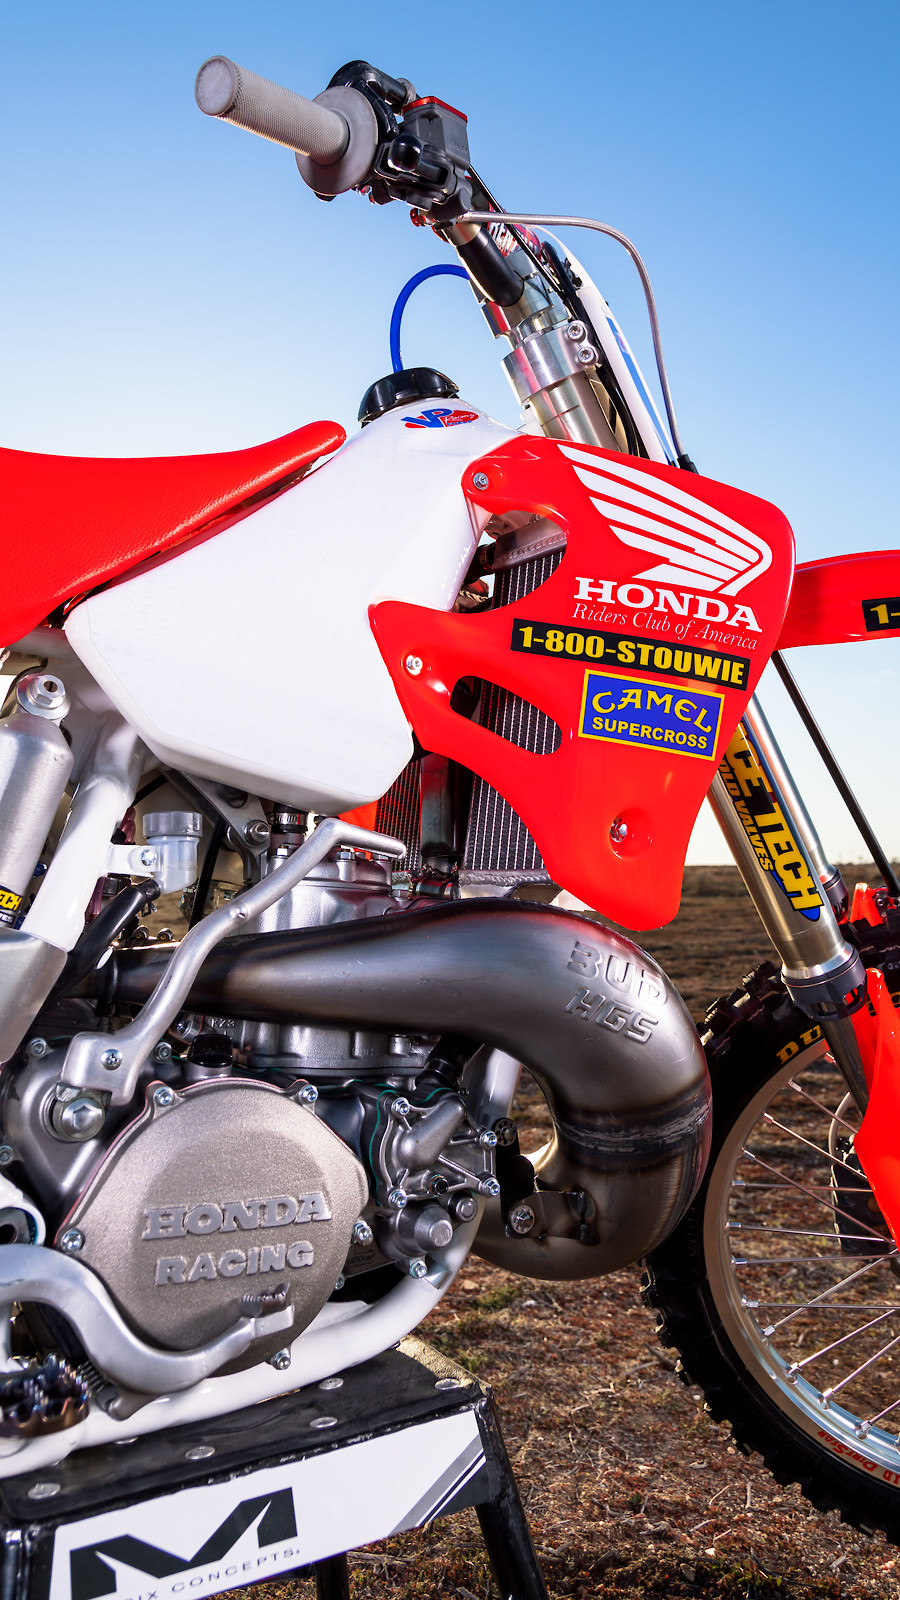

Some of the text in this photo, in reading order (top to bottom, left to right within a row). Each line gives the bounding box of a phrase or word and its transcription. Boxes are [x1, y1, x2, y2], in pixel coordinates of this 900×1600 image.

[401, 408, 453, 428] VP
[571, 602, 758, 651] Riders Club of America
[573, 576, 763, 633] HONDA
[518, 625, 745, 685] 1-800-STOUWIE
[591, 688, 712, 733] CAMEL
[591, 716, 708, 750] SUPERCROSS
[734, 800, 774, 872] VALVES
[754, 801, 824, 911] TECH
[566, 940, 668, 1005] BUD
[565, 986, 660, 1044] HGS
[141, 1192, 332, 1241] HONDA
[155, 1240, 315, 1287] RACING
